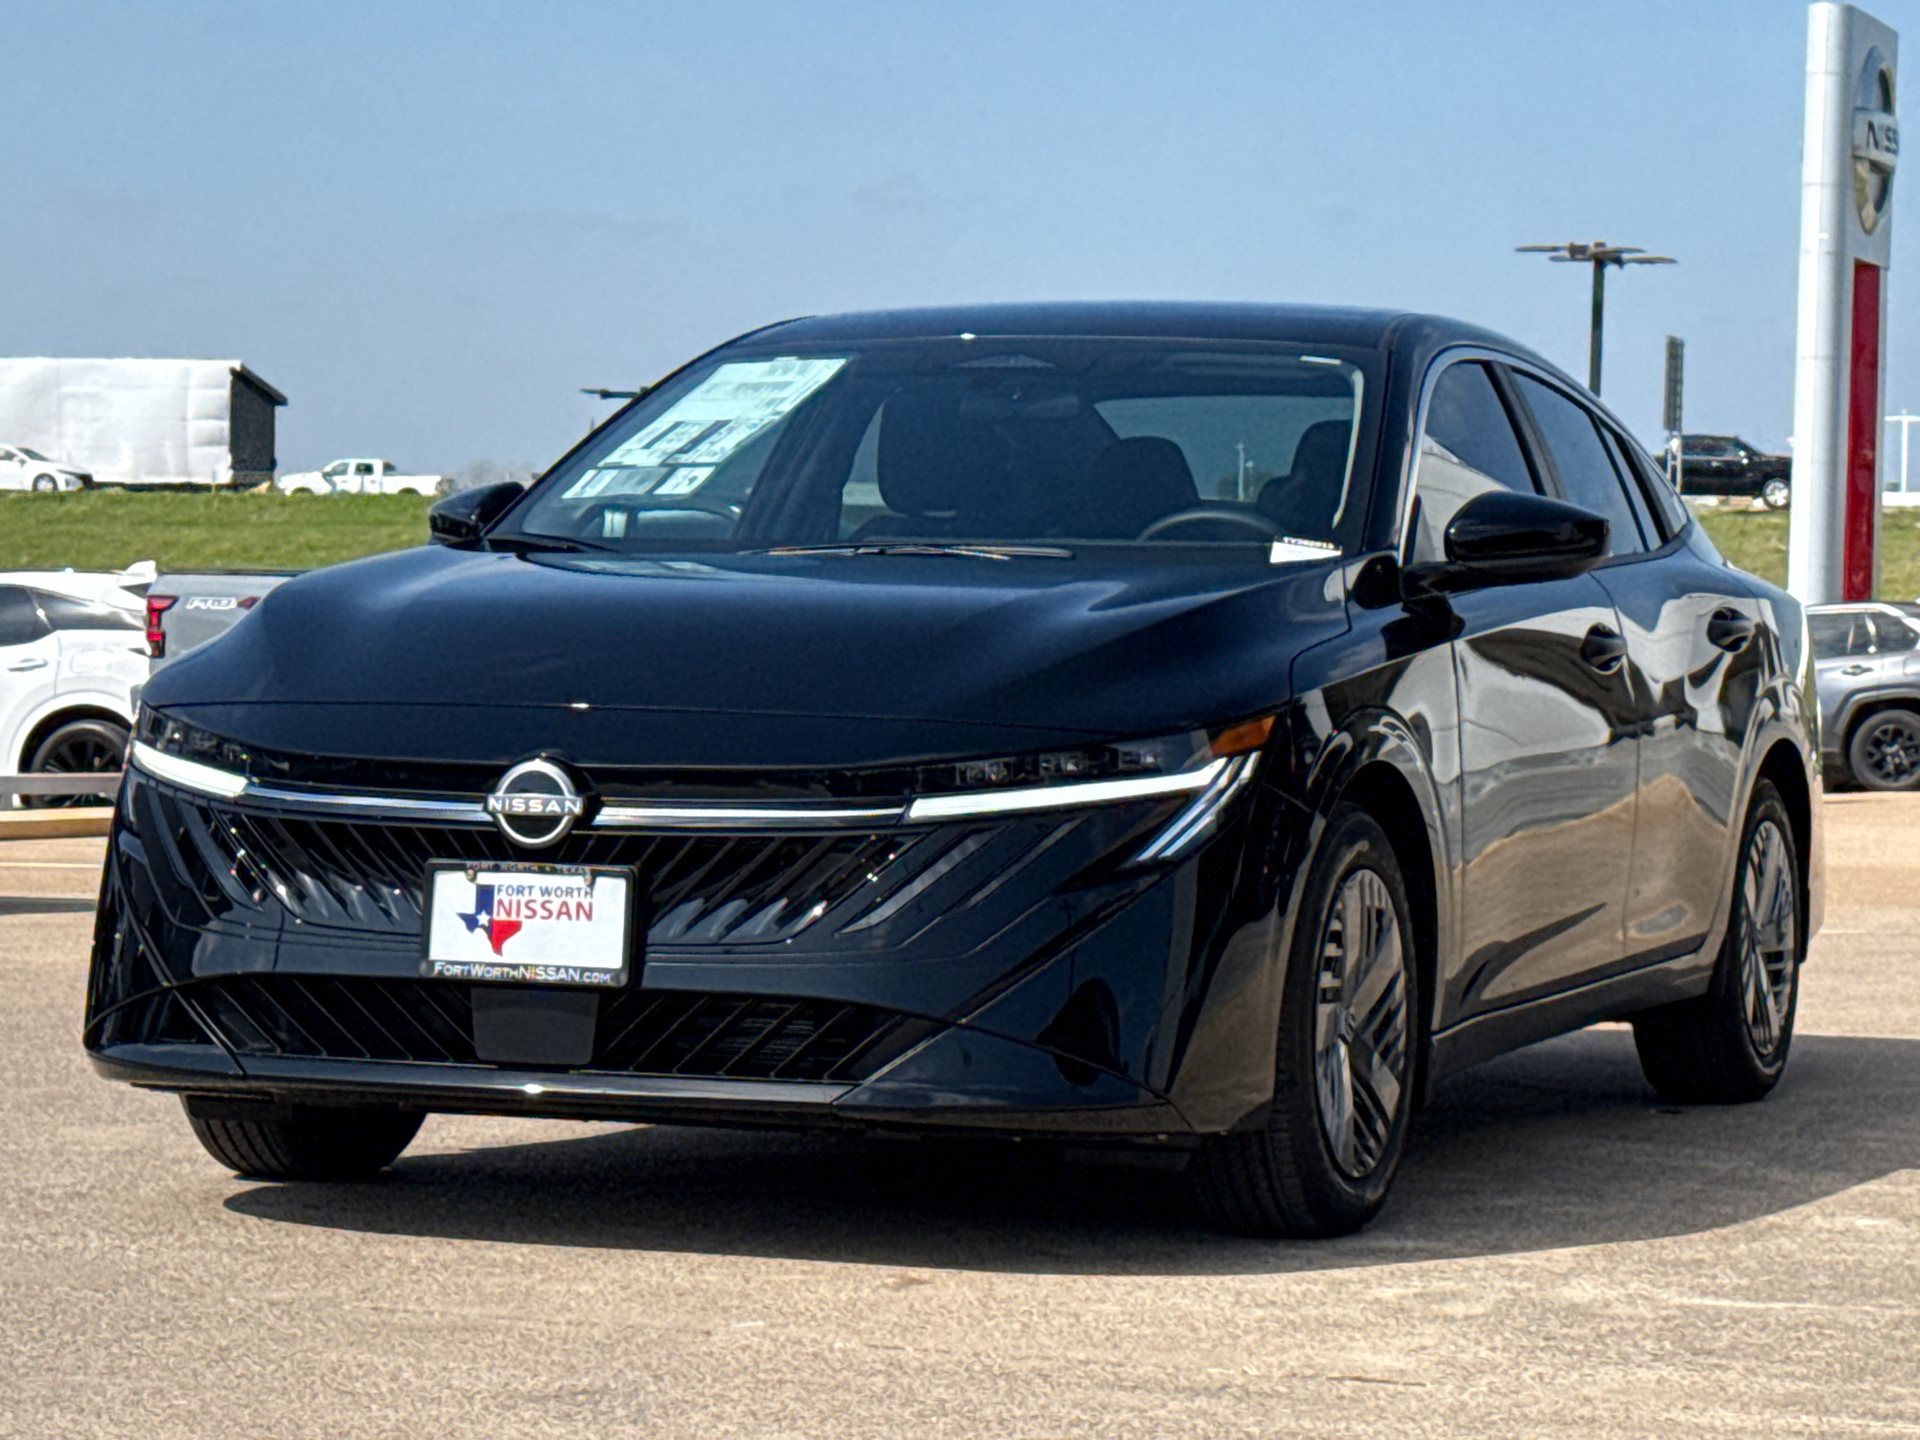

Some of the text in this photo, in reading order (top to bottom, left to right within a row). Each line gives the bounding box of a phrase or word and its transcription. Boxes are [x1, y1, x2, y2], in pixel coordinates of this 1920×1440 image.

[487, 797, 582, 814] NISSAN
[466, 862, 494, 871] FORT
[500, 863, 539, 873] WORTH
[497, 884, 594, 899] FORT WORTH
[496, 899, 594, 922] NISSAN
